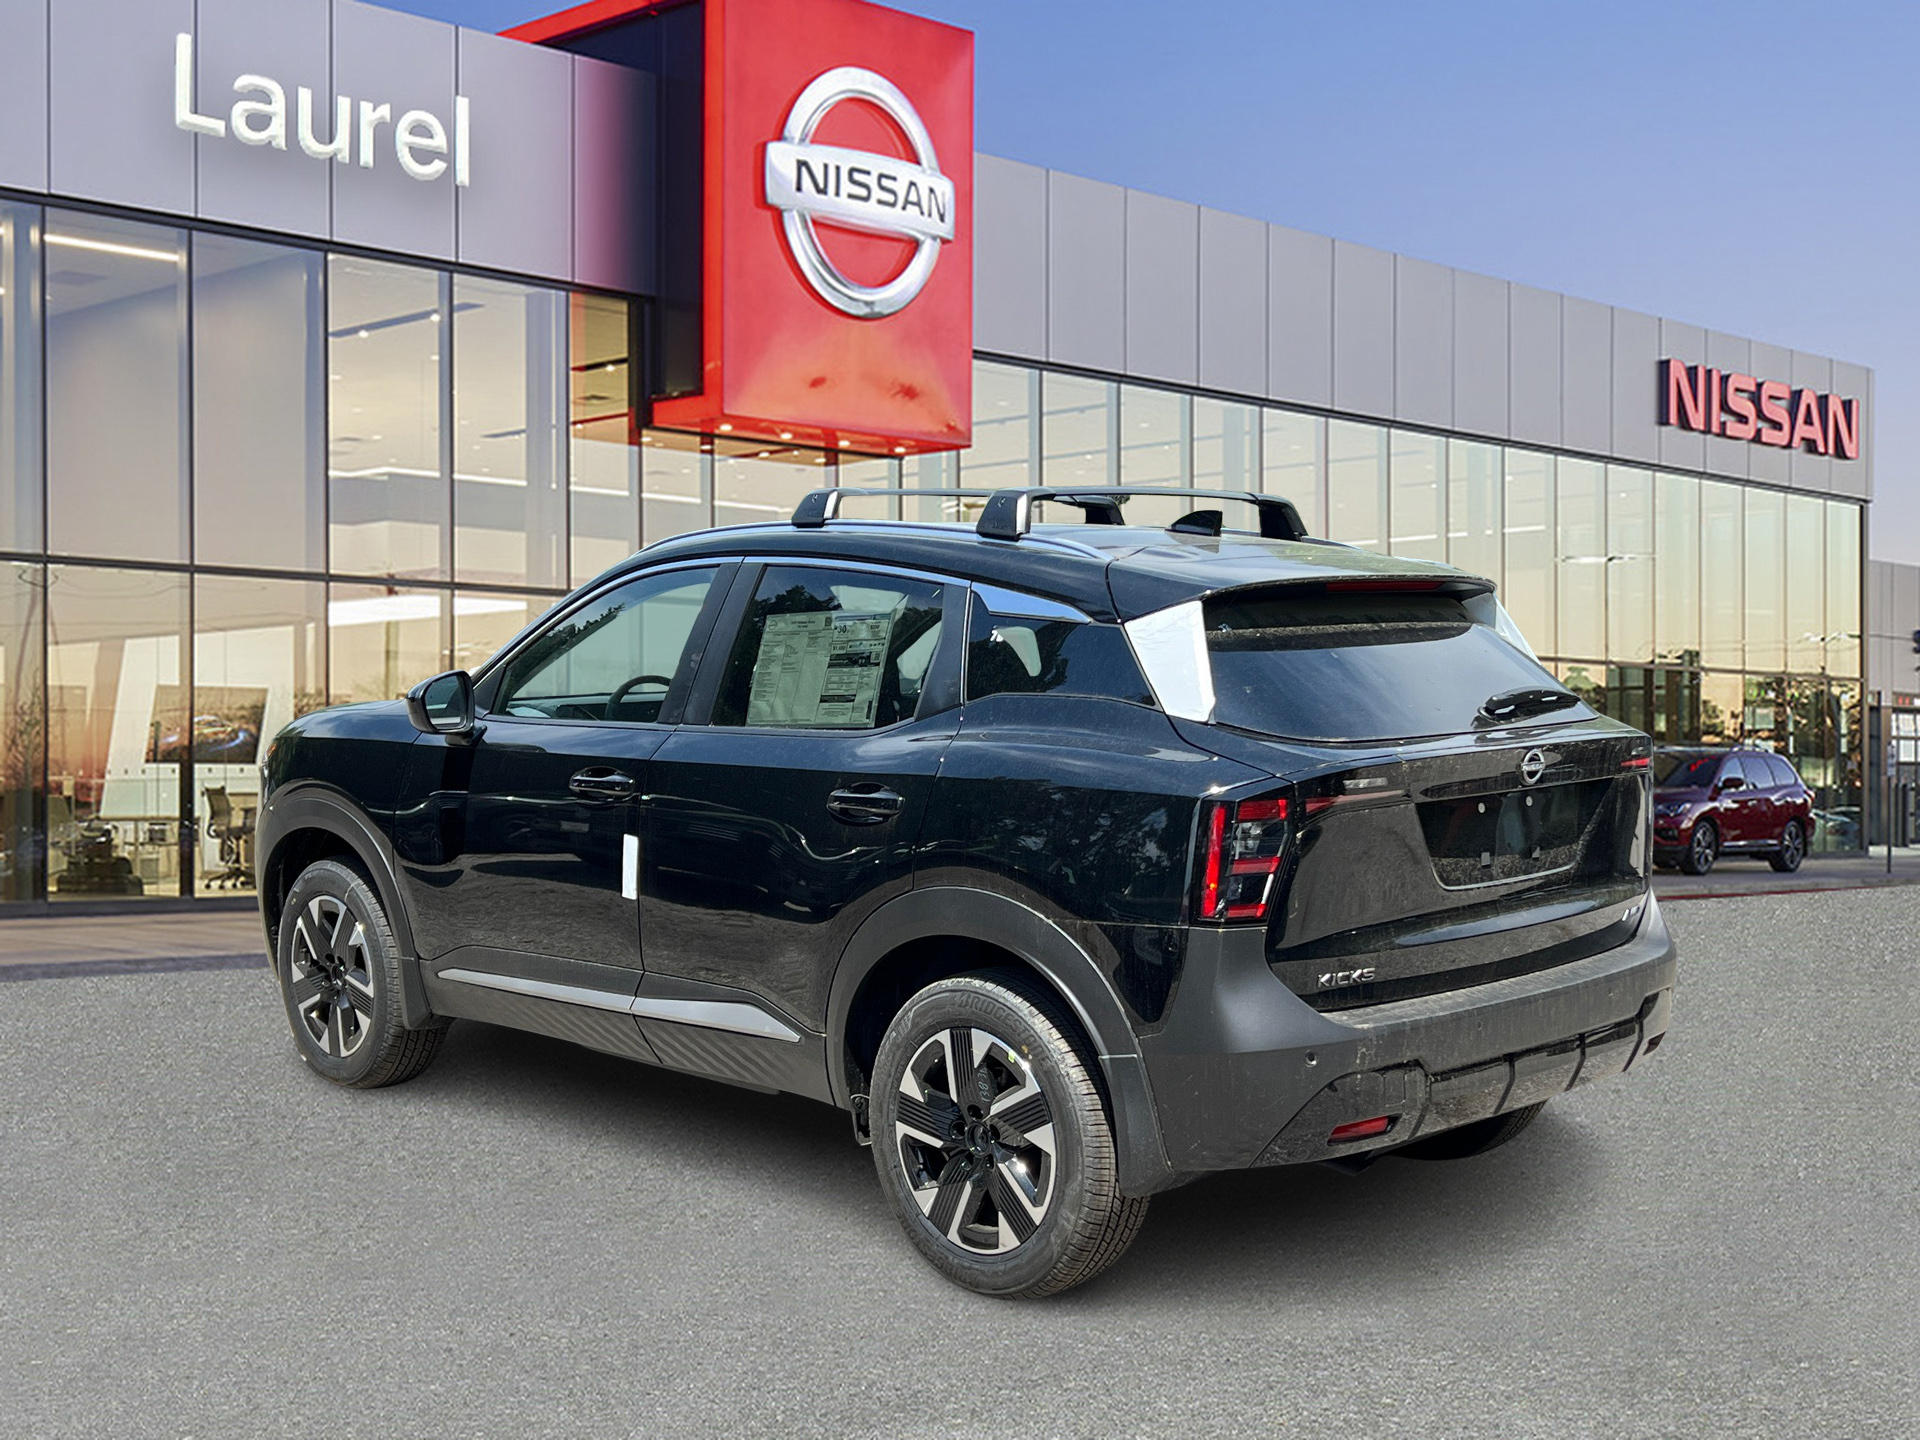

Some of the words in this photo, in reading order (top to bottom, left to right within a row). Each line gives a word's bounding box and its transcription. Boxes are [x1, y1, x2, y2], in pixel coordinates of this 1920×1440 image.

[175, 33, 470, 187] Laurel
[795, 158, 946, 224] NISSAN
[1660, 358, 1860, 460] NISSAN
[1316, 967, 1376, 988] KICKS
[957, 991, 1052, 1069] BRIDGESTONE
